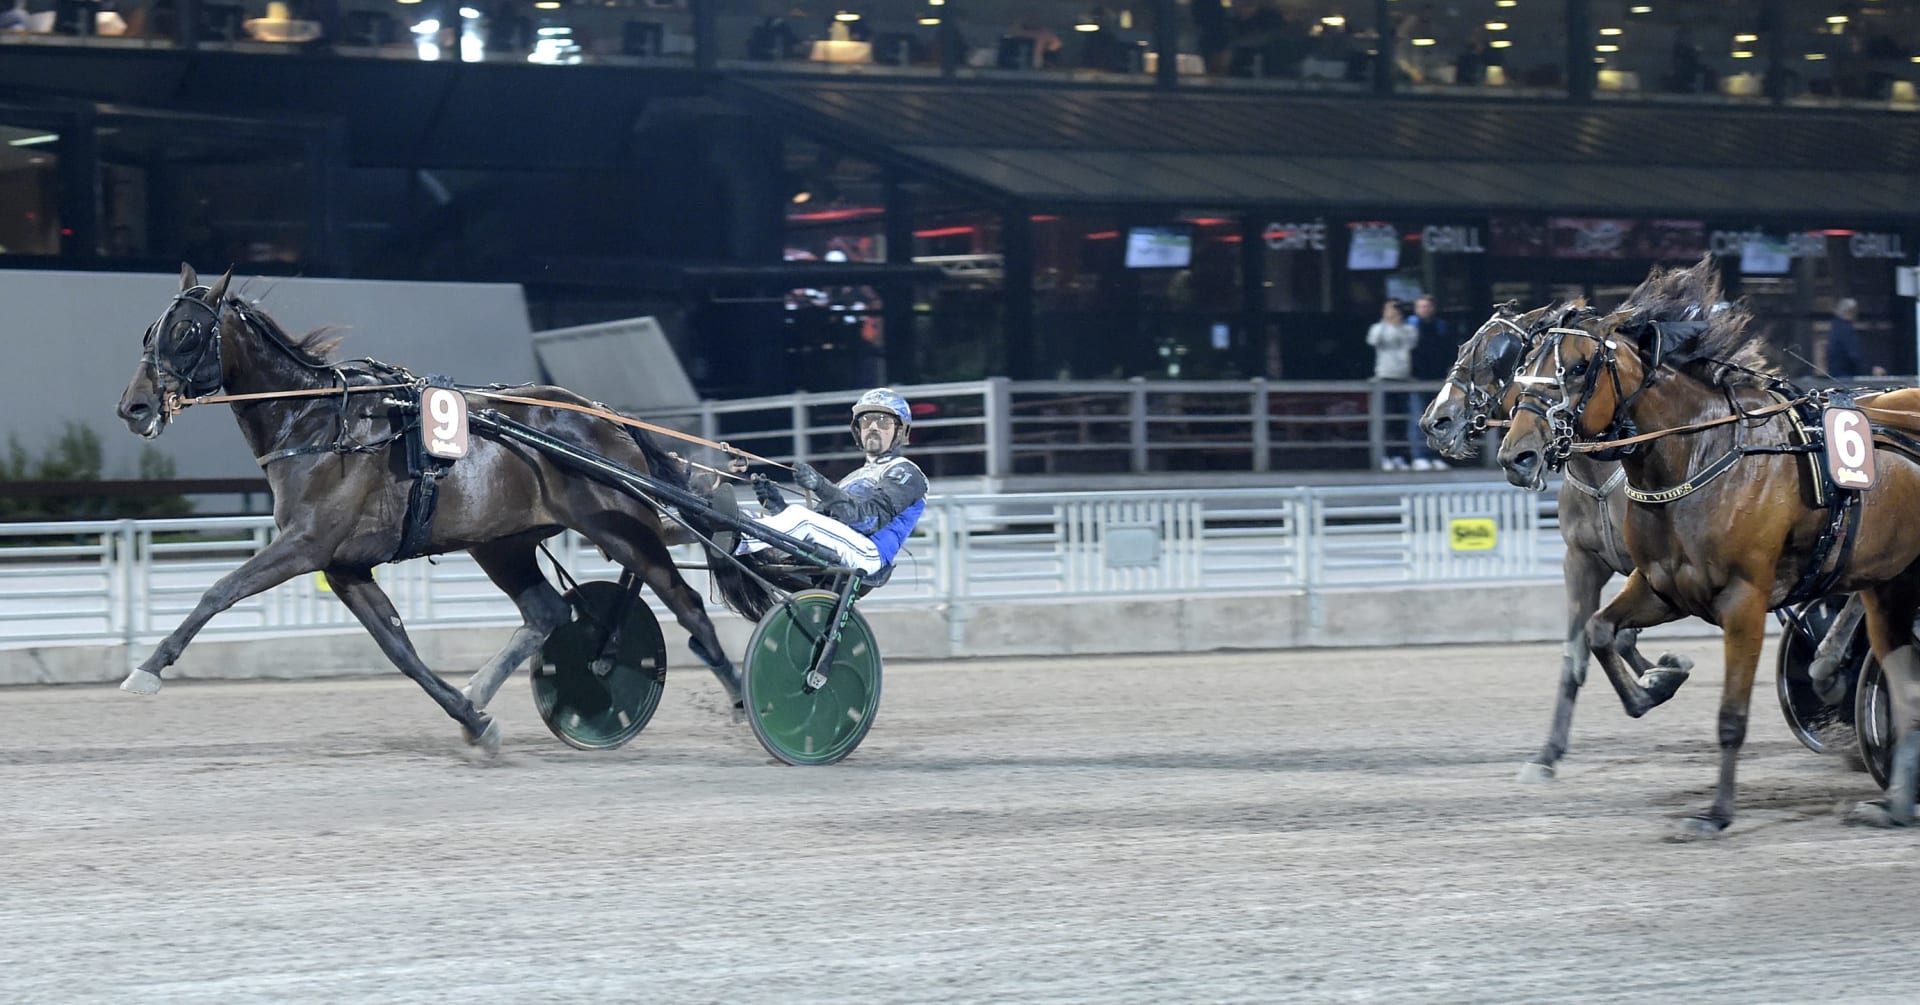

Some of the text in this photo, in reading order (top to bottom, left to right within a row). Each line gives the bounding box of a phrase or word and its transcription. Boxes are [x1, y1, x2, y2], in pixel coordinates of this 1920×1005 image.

[1421, 224, 1485, 253] GRILL
[429, 389, 459, 441] 9
[1833, 410, 1866, 469] 6
